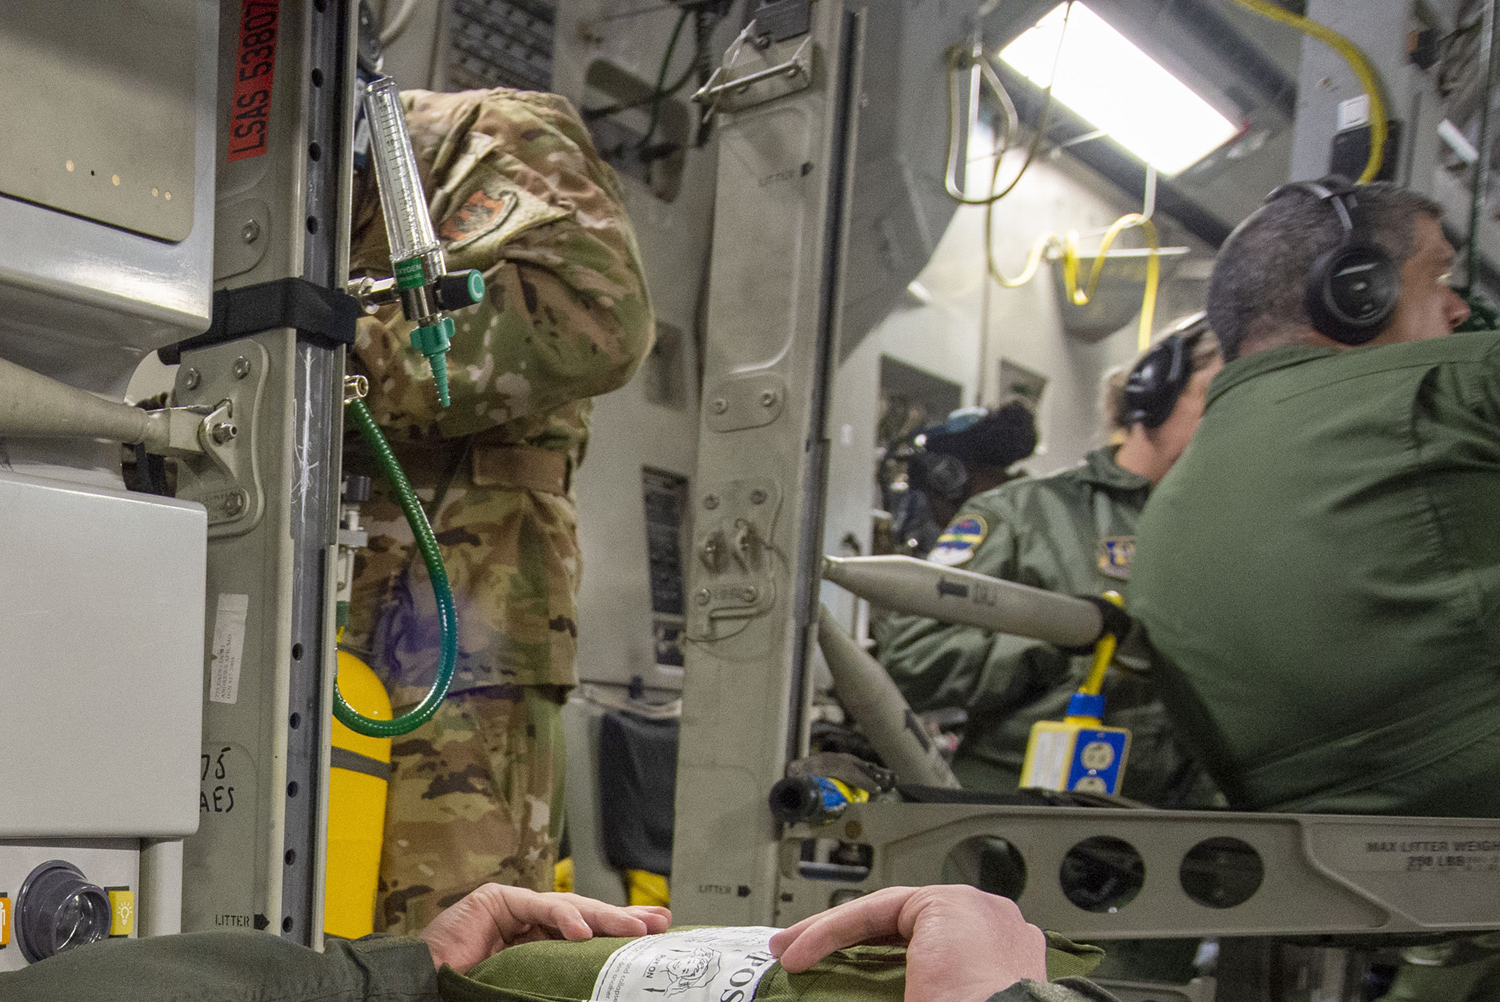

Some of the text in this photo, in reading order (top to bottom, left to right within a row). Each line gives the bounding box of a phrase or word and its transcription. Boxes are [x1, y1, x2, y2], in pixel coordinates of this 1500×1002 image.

[232, 89, 270, 154] LSAS
[200, 786, 235, 813] AES
[215, 914, 250, 927] LITTER
